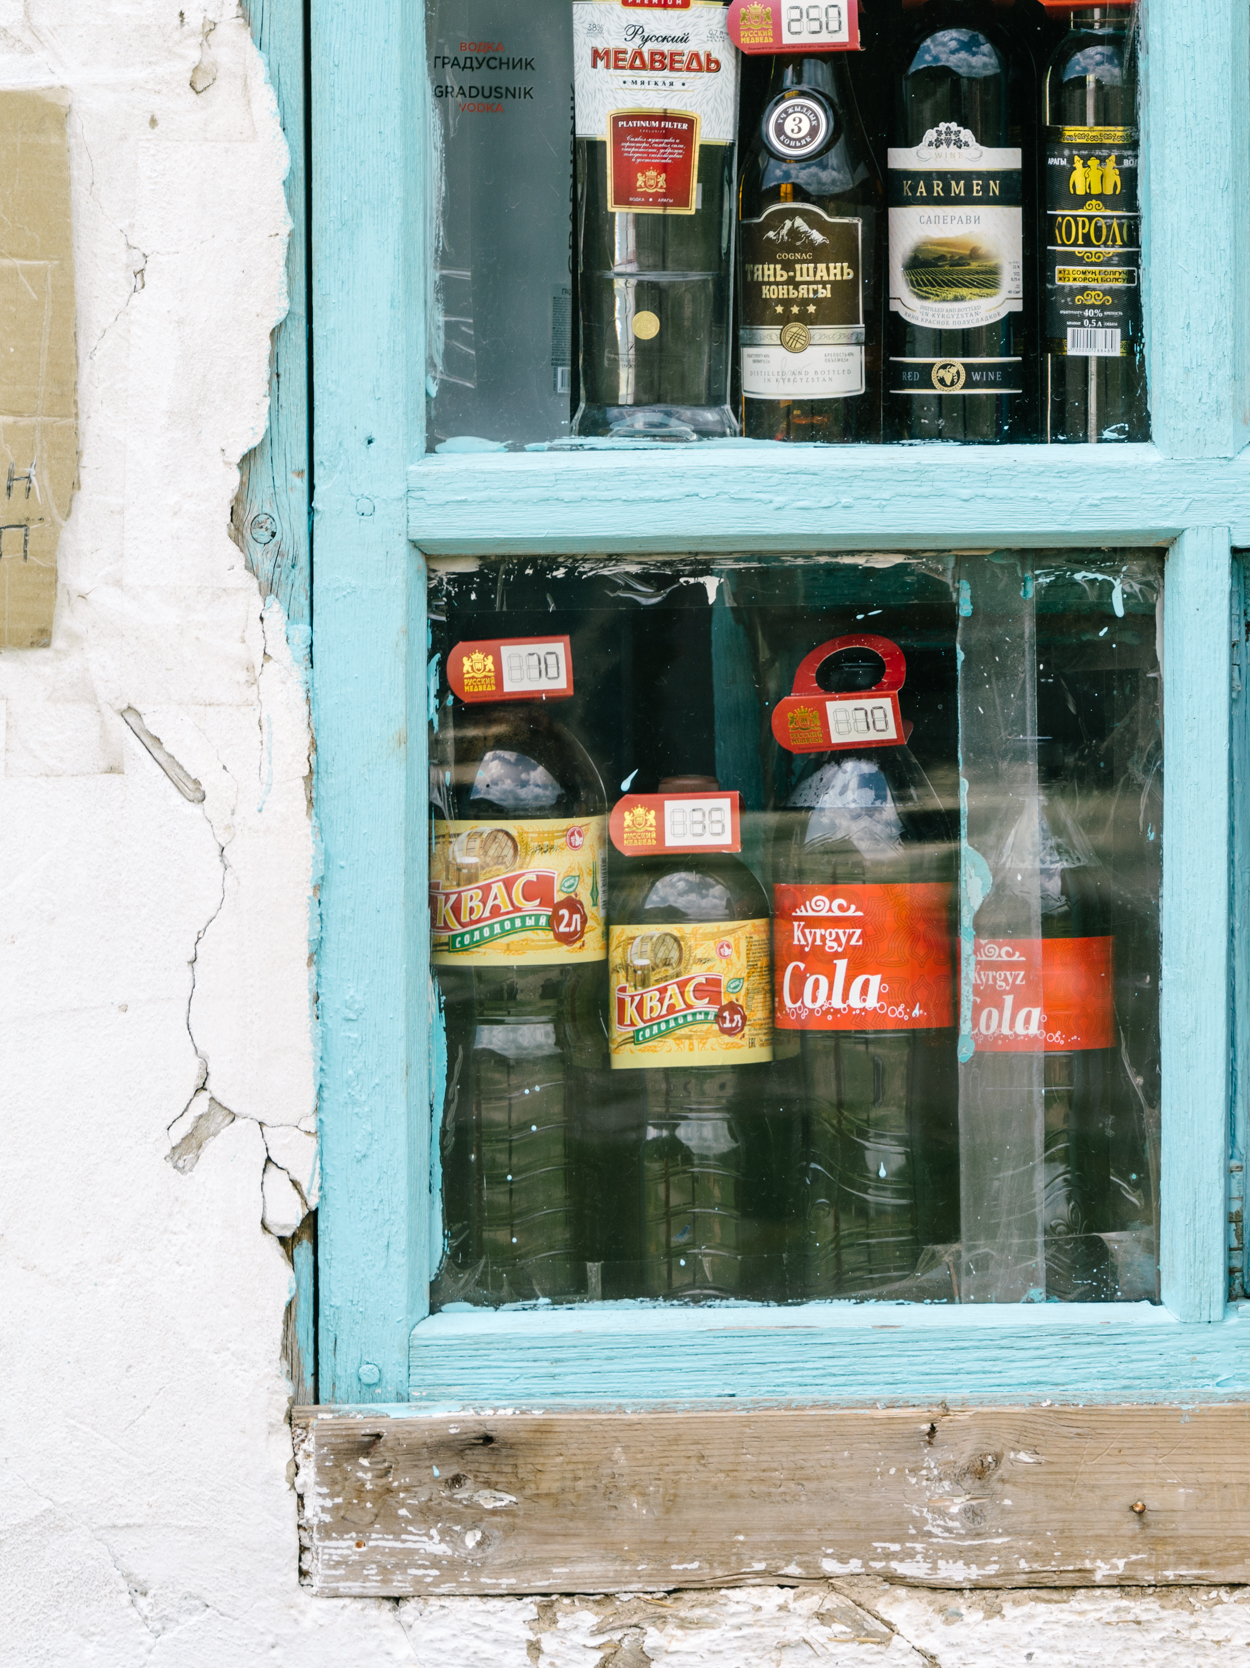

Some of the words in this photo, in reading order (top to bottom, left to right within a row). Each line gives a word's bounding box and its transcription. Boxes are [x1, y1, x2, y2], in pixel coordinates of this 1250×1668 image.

[624, 24, 690, 48] Русский
[459, 42, 504, 52] ВОДКА
[433, 56, 536, 72] ГРАДУСНИК
[591, 47, 721, 73] МЕДВЕДЬ
[434, 85, 534, 100] GRADUSNIK
[459, 103, 504, 113] VODKA
[661, 121, 688, 130] FILTER
[790, 116, 803, 134] 3
[780, 134, 812, 147] КОНЬЯК
[1048, 157, 1067, 166] АРАГЫ
[903, 180, 1000, 197] KARMEN
[919, 215, 981, 225] САПЕРАВИ
[745, 262, 854, 282] ТЯНЬ-ШАНЬ
[762, 284, 832, 299] КОНЬЯГЫ
[932, 311, 979, 319] KYRGYZSTAN
[1083, 309, 1103, 317] 40%
[920, 317, 950, 326] КРАСНОЕ
[902, 372, 920, 381] RED
[972, 372, 1002, 381] WINE
[436, 874, 542, 930] КВАС
[456, 915, 546, 948] СОЛОДОВЫЙ
[792, 921, 863, 952] Kyrgyz
[783, 958, 882, 1009] Cola
[624, 976, 710, 1027] КВАС
[638, 1010, 716, 1040] СОЛОДОВЫЙ
